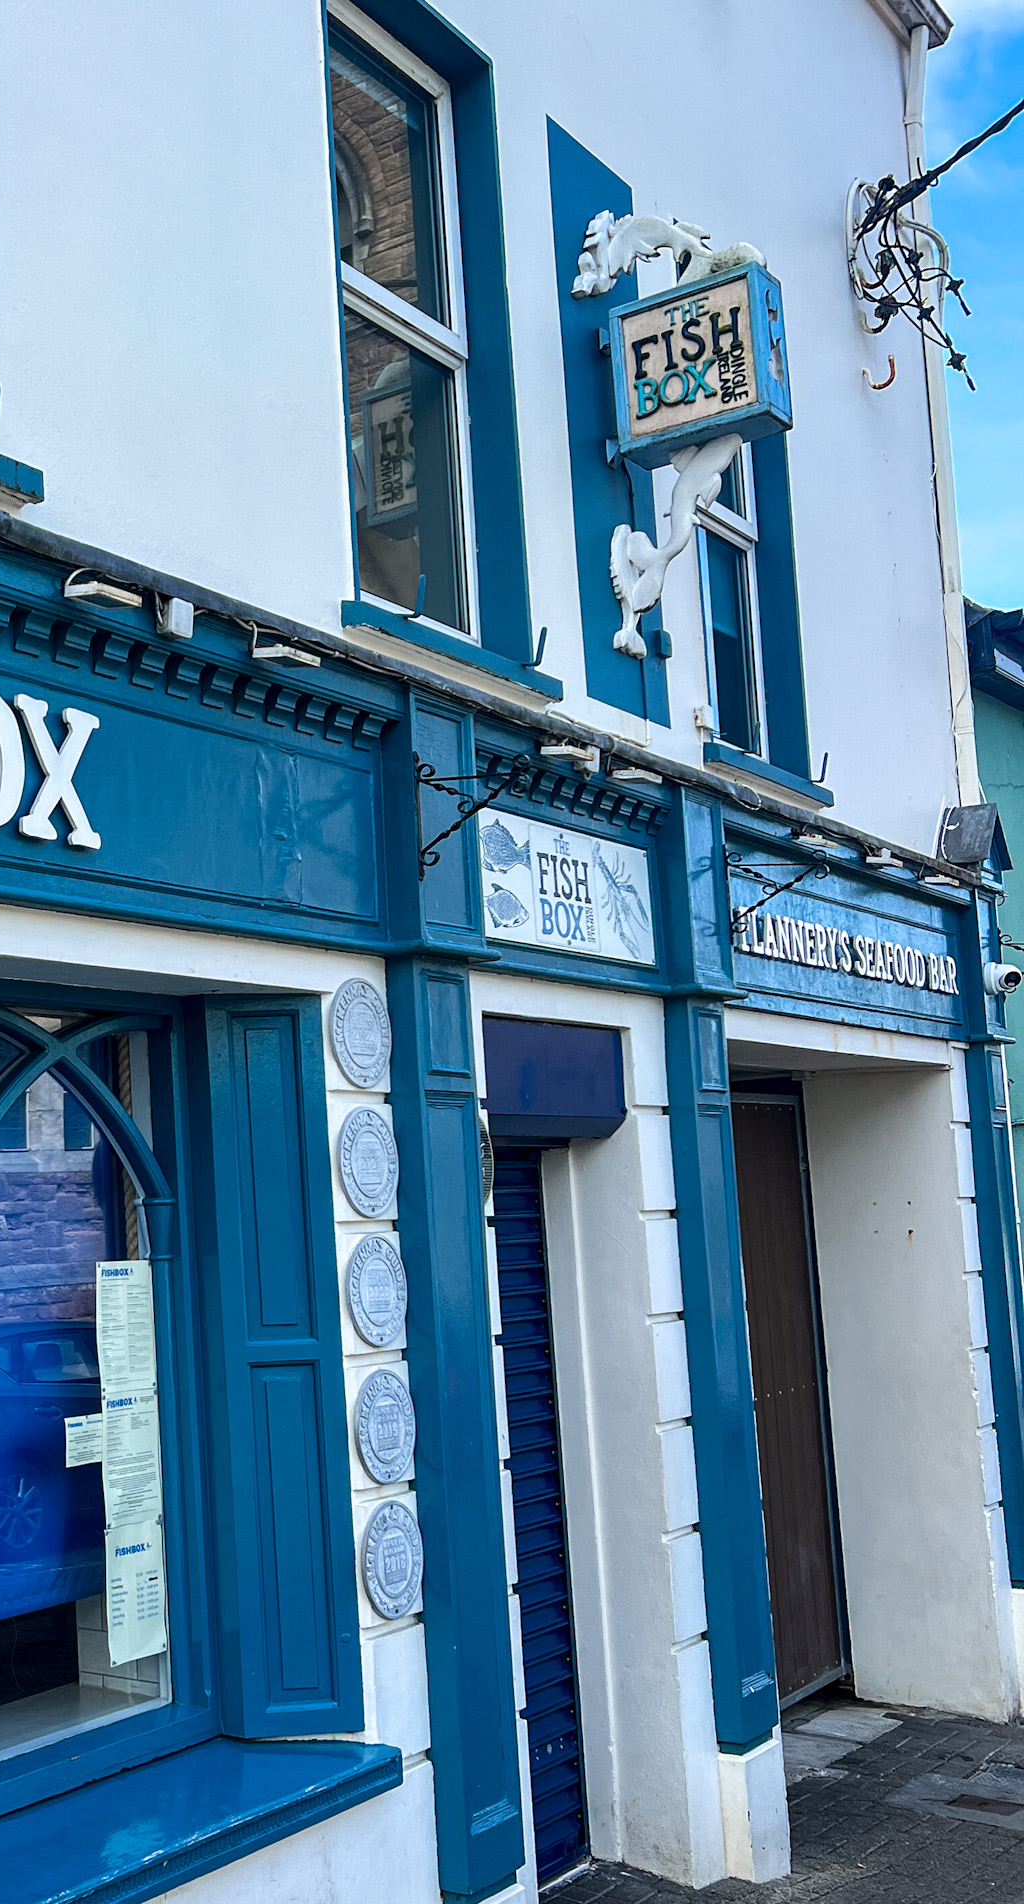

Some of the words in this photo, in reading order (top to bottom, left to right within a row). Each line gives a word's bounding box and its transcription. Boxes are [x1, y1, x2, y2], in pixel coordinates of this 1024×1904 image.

[664, 296, 709, 326] THE
[631, 307, 741, 380] FISH
[633, 357, 717, 420] BOX
[716, 351, 733, 403] IRELAND
[728, 341, 749, 402] DINGLE
[553, 838, 570, 856] THE
[537, 852, 592, 904] FISH
[540, 898, 586, 942] BOX
[853, 934, 926, 987] SEAFOOD
[928, 953, 959, 995] BAR
[115, 1543, 146, 1557] FISHBOX
